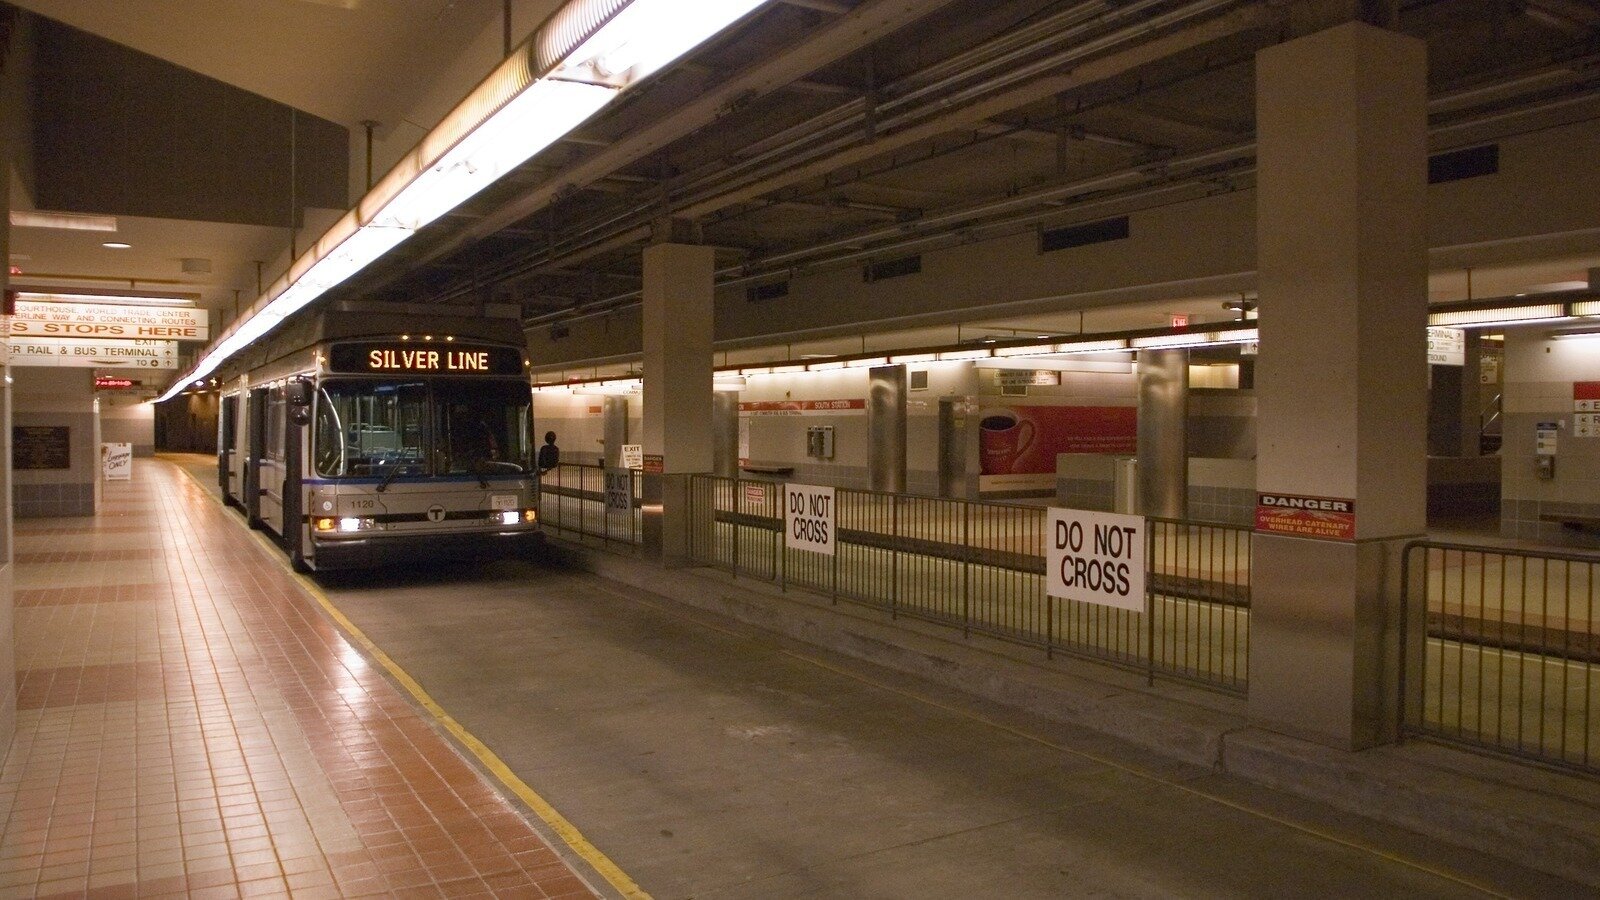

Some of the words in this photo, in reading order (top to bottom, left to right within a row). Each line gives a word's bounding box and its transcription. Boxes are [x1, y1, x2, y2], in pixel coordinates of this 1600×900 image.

[76, 314, 95, 322] AND
[100, 315, 157, 324] CONNECTING
[162, 318, 196, 326] ROUTES
[156, 310, 190, 318] CENTER
[44, 323, 124, 335] STOPS
[138, 326, 197, 337] HERE
[27, 345, 53, 355] RAIL
[60, 346, 67, 355] &
[74, 347, 97, 356] BUS
[105, 347, 158, 357] TERMINAL
[369, 349, 439, 369] SILVER
[447, 351, 489, 370] LINE
[351, 500, 374, 509] 1120
[790, 491, 804, 515] DO
[809, 494, 831, 518] NOT
[1262, 496, 1348, 512] DANGER
[1260, 516, 1303, 526] OVERHEAD
[1305, 520, 1350, 530] CATENARY
[1268, 523, 1294, 532] WIRES
[1297, 526, 1312, 534] ARE
[1315, 528, 1341, 536] ALIVE
[793, 517, 828, 545] CROSS
[1056, 519, 1083, 553] DO
[1094, 523, 1136, 560] NOT
[1061, 554, 1130, 597] CROSS
